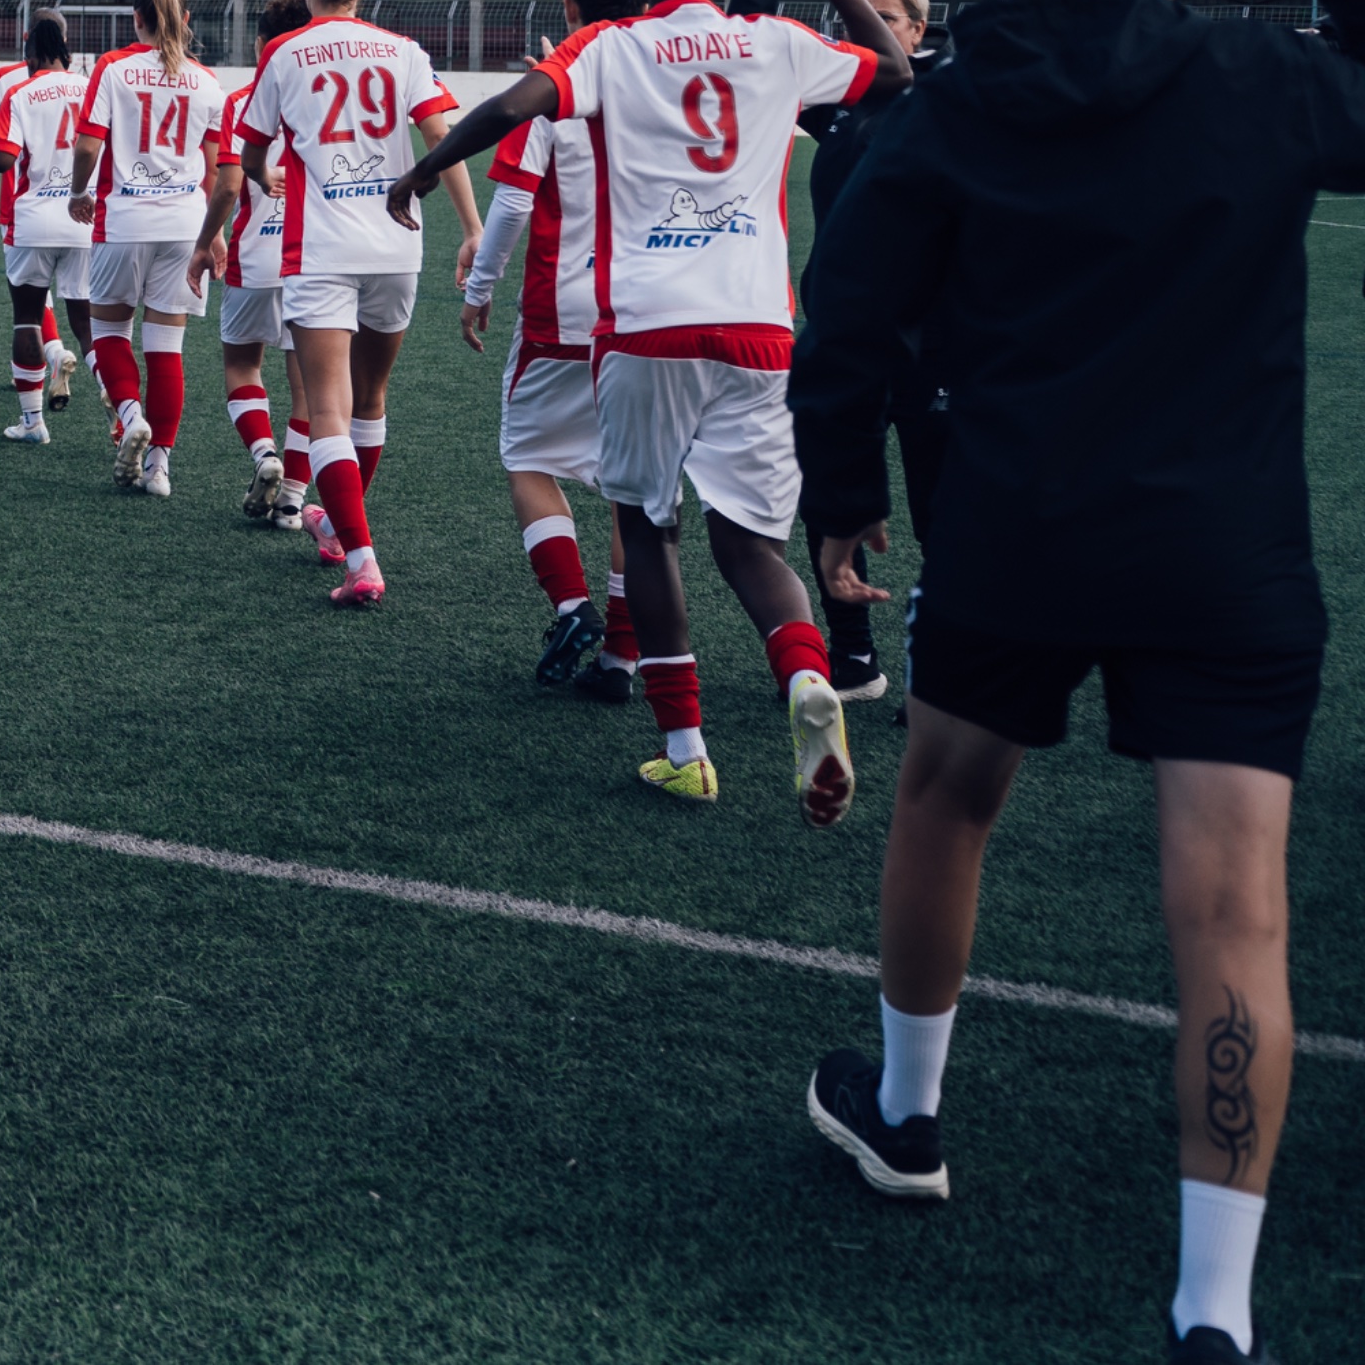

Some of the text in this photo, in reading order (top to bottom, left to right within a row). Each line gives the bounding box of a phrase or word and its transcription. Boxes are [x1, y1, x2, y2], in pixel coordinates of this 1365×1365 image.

[292, 39, 398, 69] TEINTURIER
[655, 33, 753, 65] NDIAYE
[124, 68, 199, 91] CHEZEAU
[135, 91, 190, 157] 14
[311, 65, 397, 146] 29
[681, 72, 739, 174] 9
[55, 102, 80, 151] 4
[323, 185, 389, 200] MICHEL
